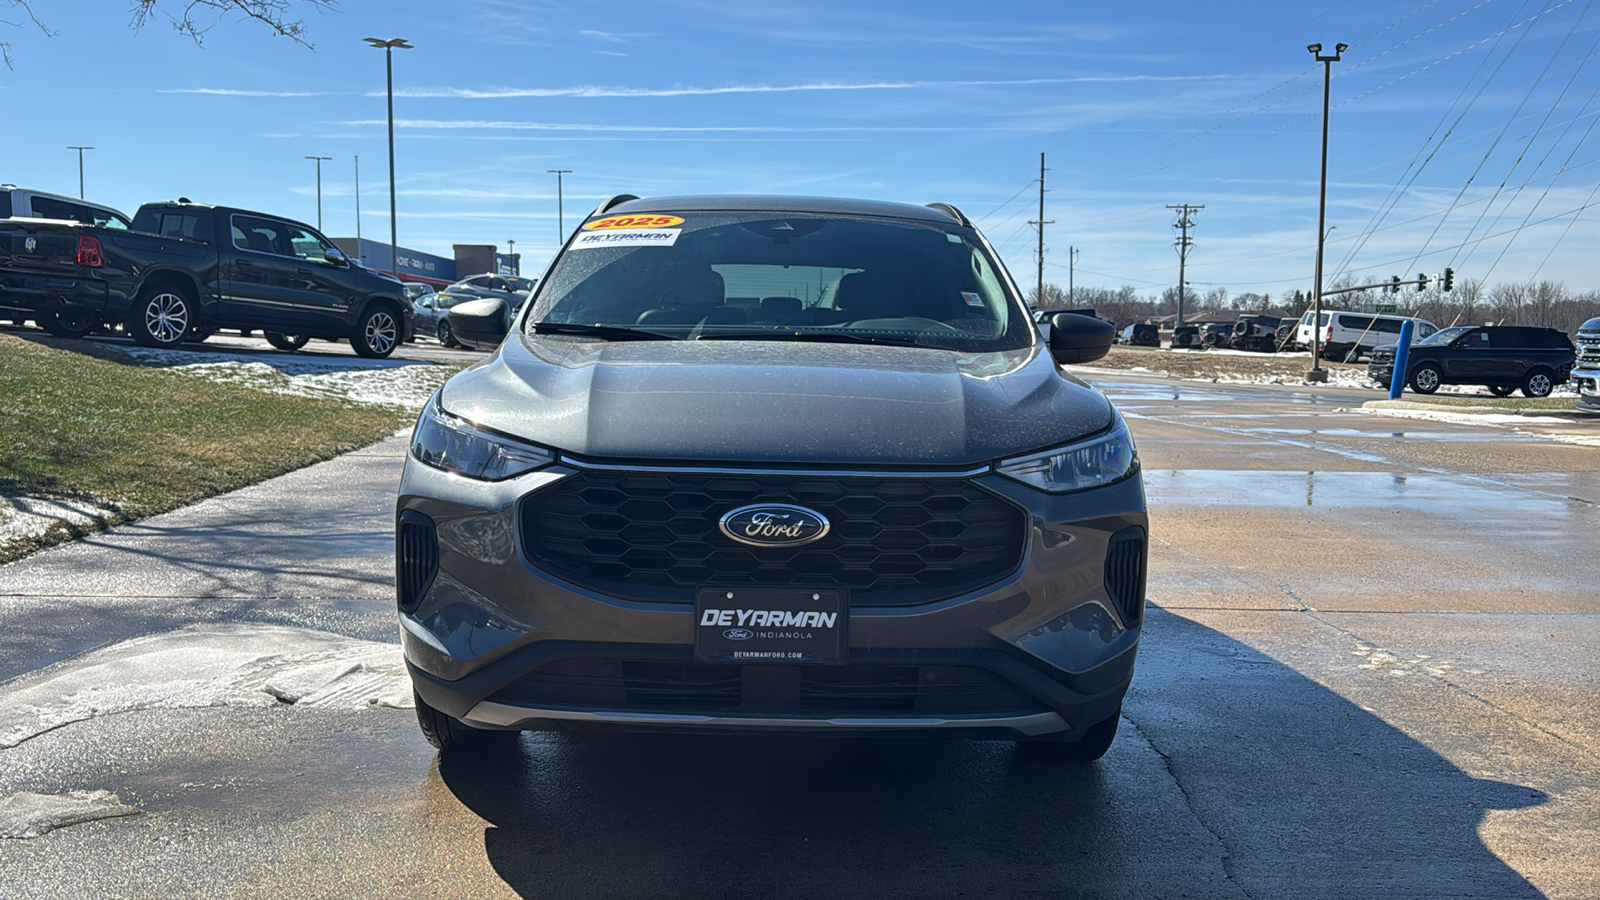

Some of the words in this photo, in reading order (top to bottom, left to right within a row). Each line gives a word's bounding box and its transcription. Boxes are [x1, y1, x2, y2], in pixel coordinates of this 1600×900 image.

[592, 217, 675, 228] 2025
[582, 233, 673, 242] DEYARMAN
[745, 511, 804, 538] Ford
[699, 609, 837, 628] DEYARMAN
[728, 629, 748, 639] Ford
[757, 631, 812, 639] INDIANOLA
[734, 651, 802, 659] DEYARMANFORD.COM
